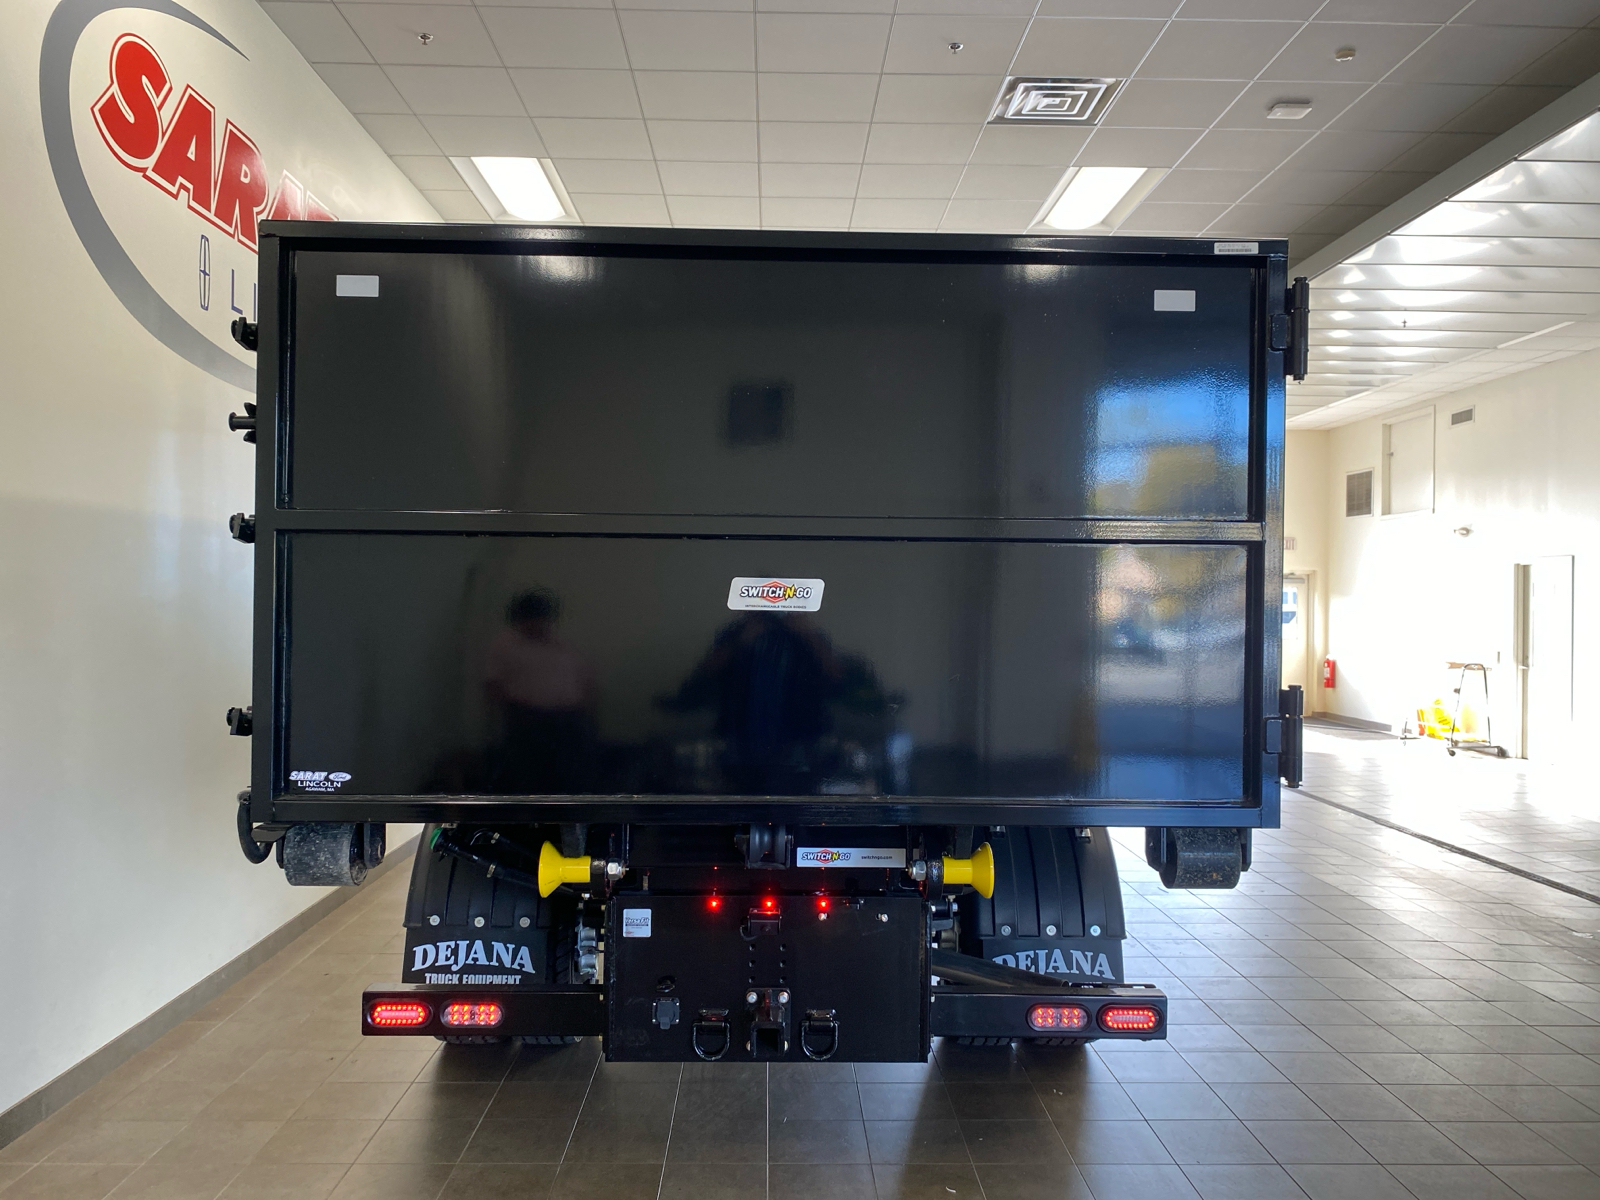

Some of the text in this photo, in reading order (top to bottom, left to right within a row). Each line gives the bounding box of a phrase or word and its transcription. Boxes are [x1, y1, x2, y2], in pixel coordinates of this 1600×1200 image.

[91, 32, 340, 254] SARA
[289, 771, 328, 780] SARAT
[411, 939, 536, 974] DEJANA
[425, 973, 522, 985] TRUCK EQUIPMENT
